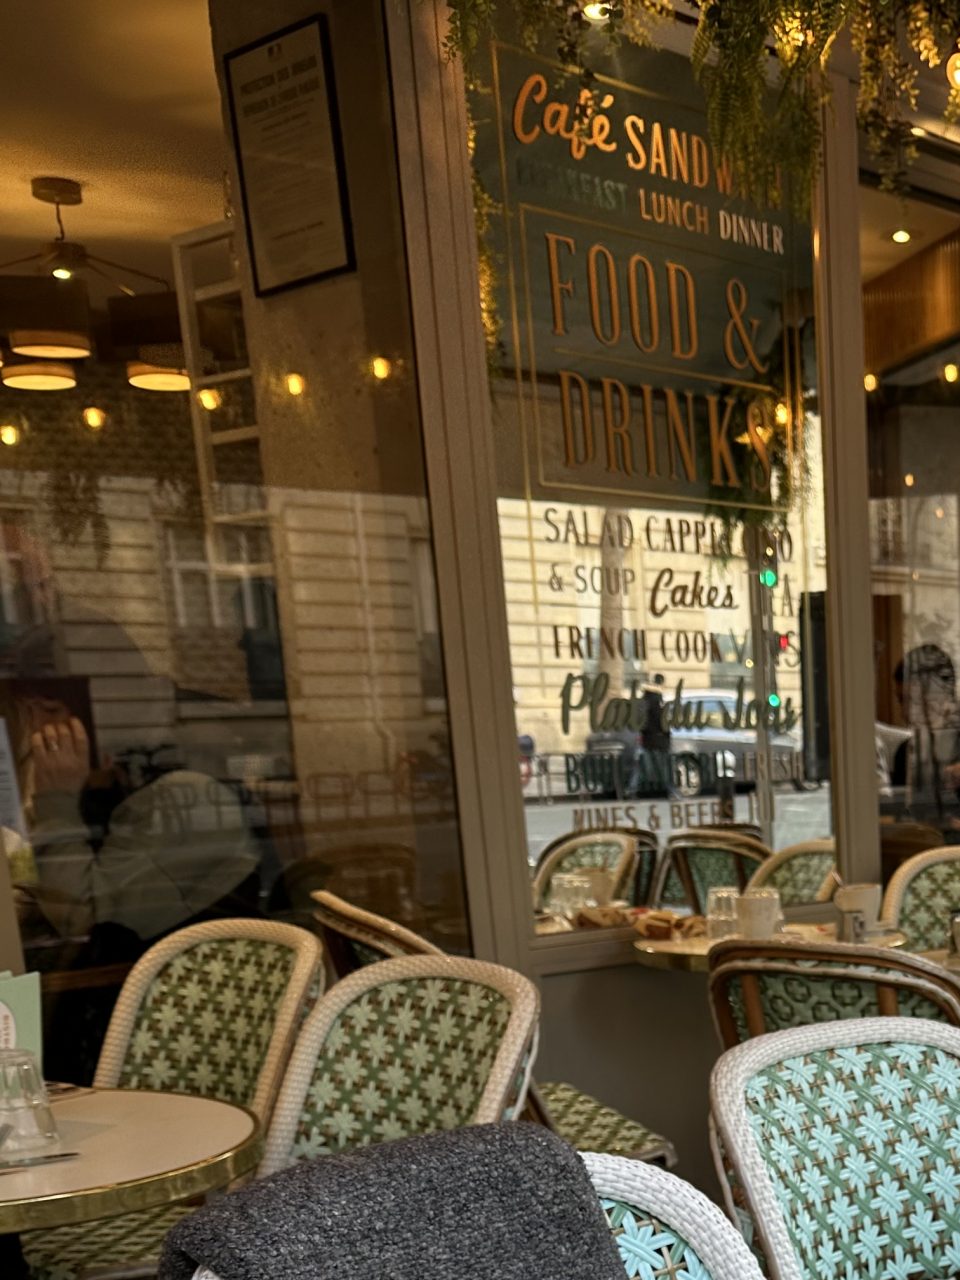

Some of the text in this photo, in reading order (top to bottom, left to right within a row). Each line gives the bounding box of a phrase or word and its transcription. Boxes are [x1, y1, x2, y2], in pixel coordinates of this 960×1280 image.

[639, 188, 709, 235] LUNCH
[719, 209, 784, 255] DINNER
[545, 232, 768, 374] FOOD &
[560, 370, 772, 492] DRINKS
[544, 507, 634, 549] SALAD
[550, 562, 563, 592] &
[575, 564, 635, 596] SOUP
[650, 568, 739, 617] Cakes
[552, 624, 647, 661] FRENCH
[561, 672, 645, 735] Plat
